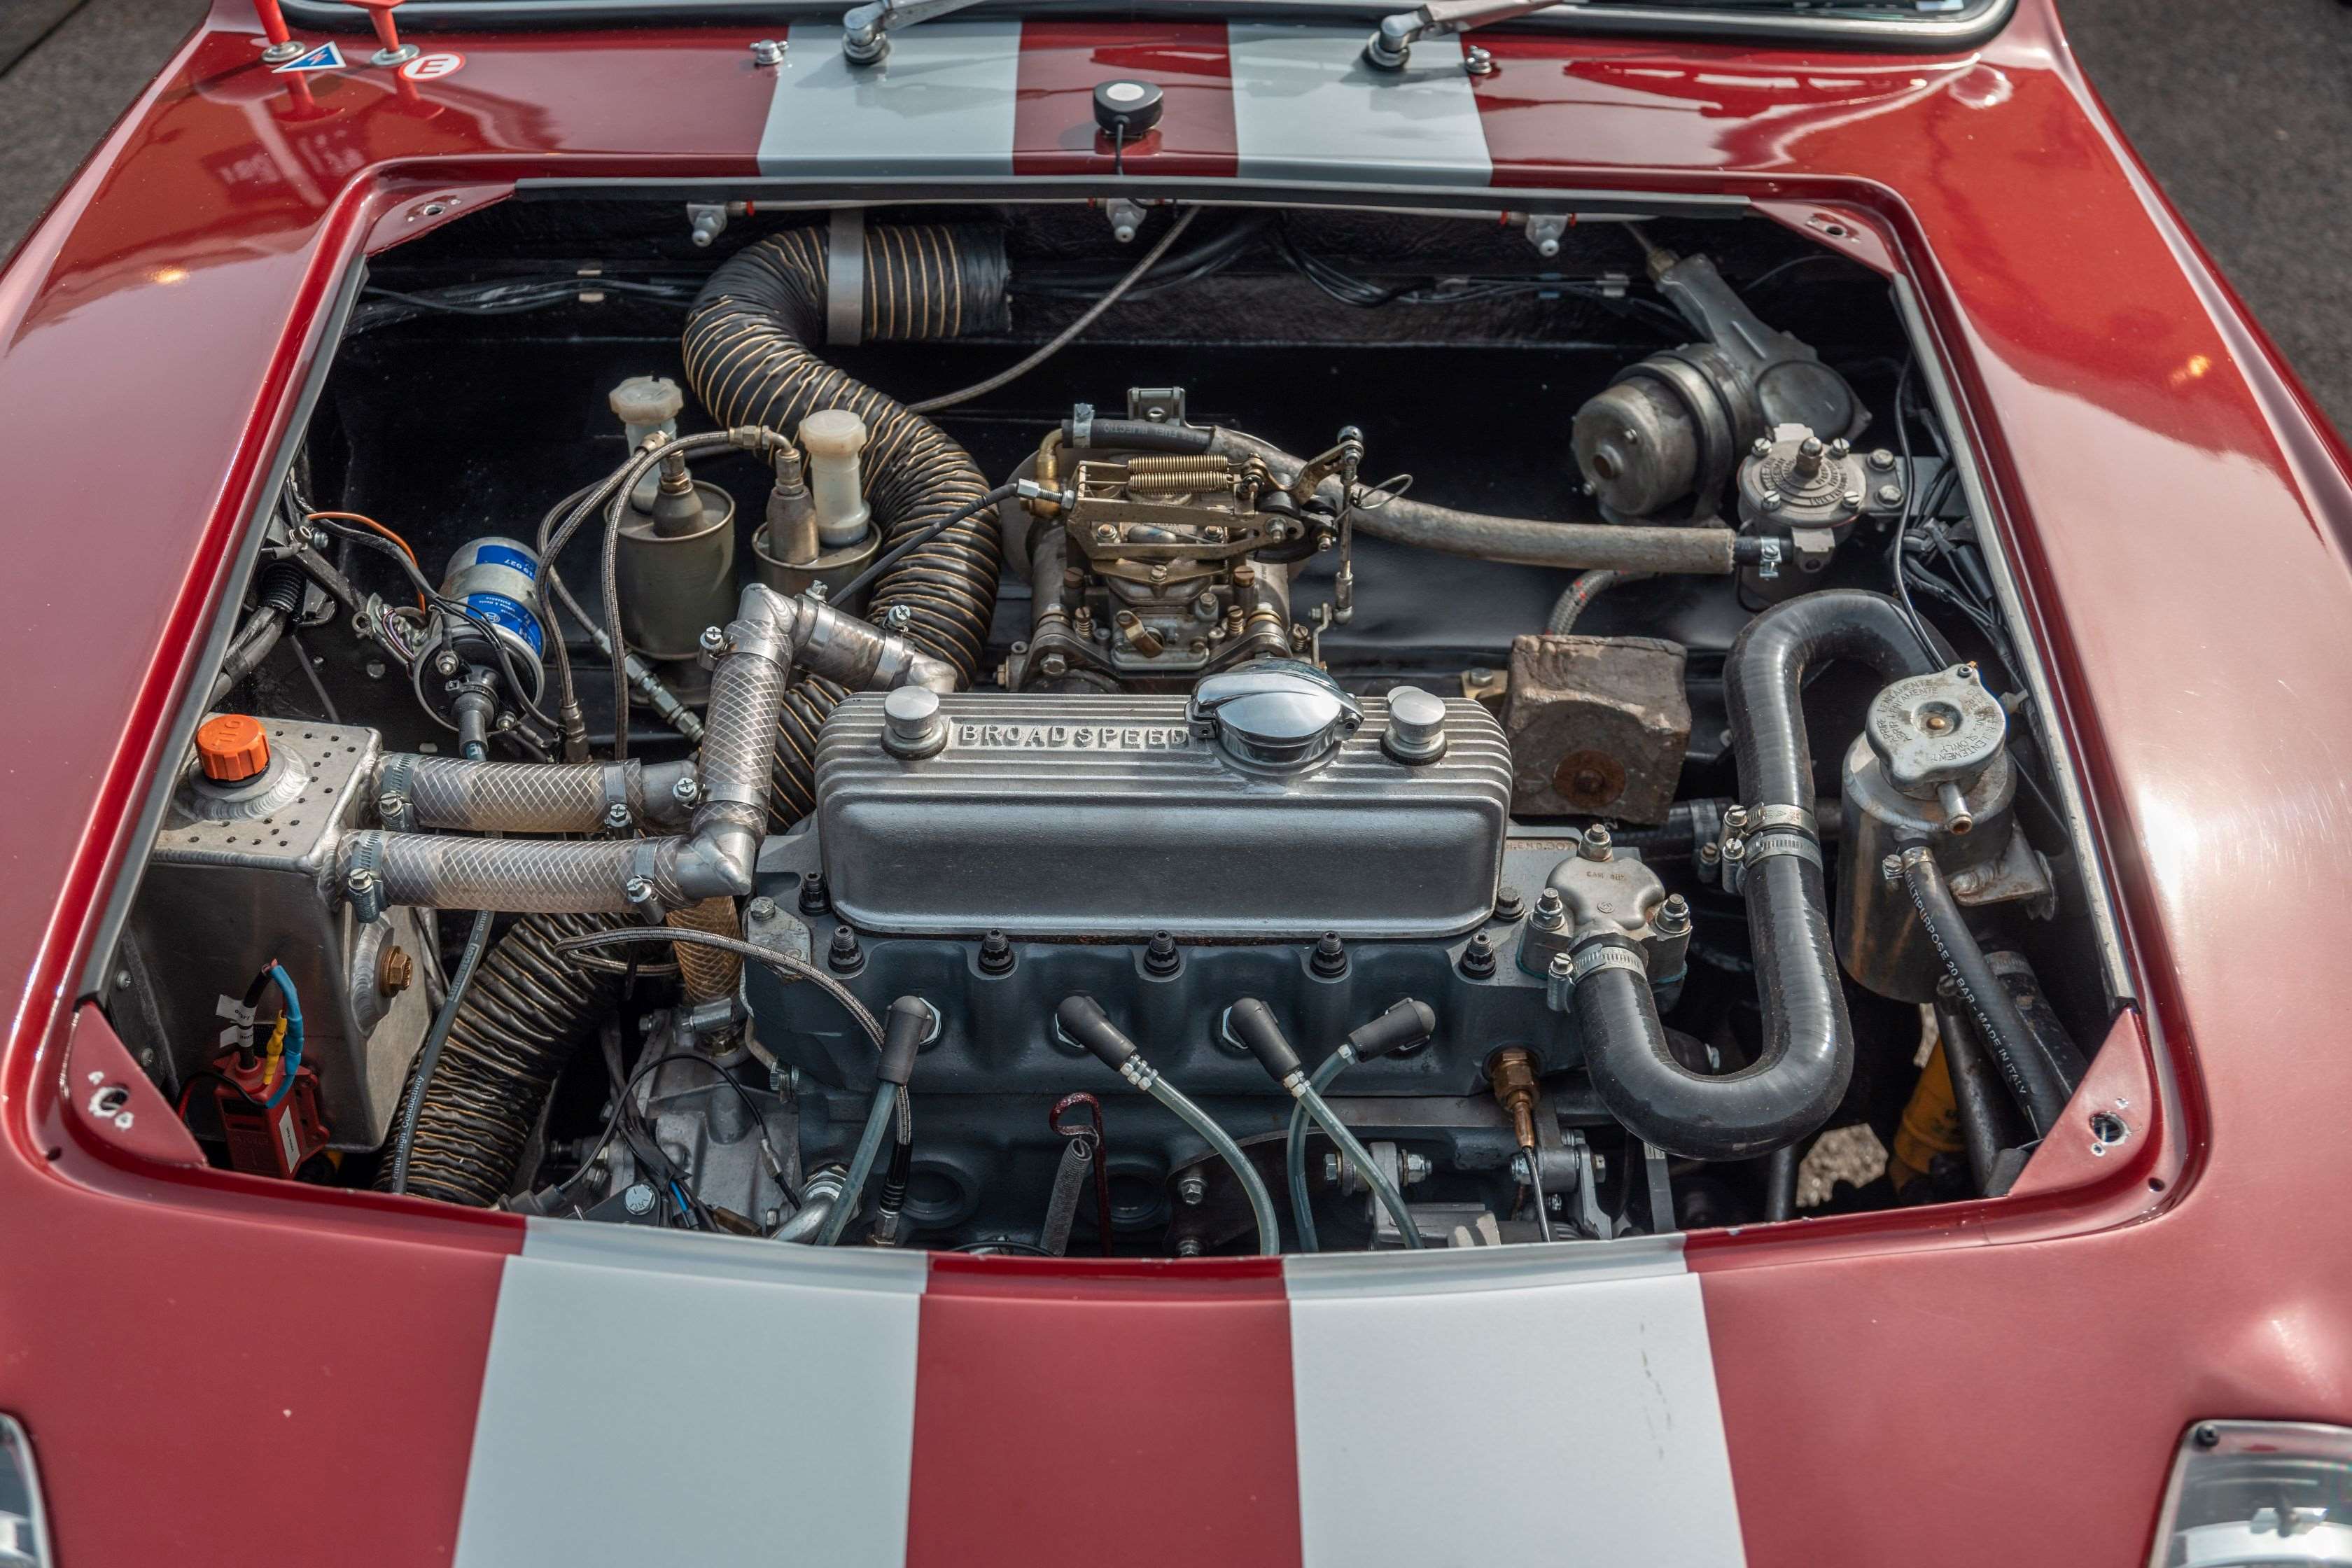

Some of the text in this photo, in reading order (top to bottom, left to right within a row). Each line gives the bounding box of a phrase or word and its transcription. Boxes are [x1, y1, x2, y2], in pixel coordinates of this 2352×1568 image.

[414, 58, 449, 74] E
[957, 724, 1190, 748] BROADSPEED
[1905, 869, 1949, 961] MULTIPURPOSE
[1945, 961, 1959, 978] 20
[1956, 977, 1975, 1004] BAR
[1977, 1011, 2001, 1046] MADE
[1998, 1047, 2010, 1062] IN
[2005, 1060, 2028, 1095] ITALY
